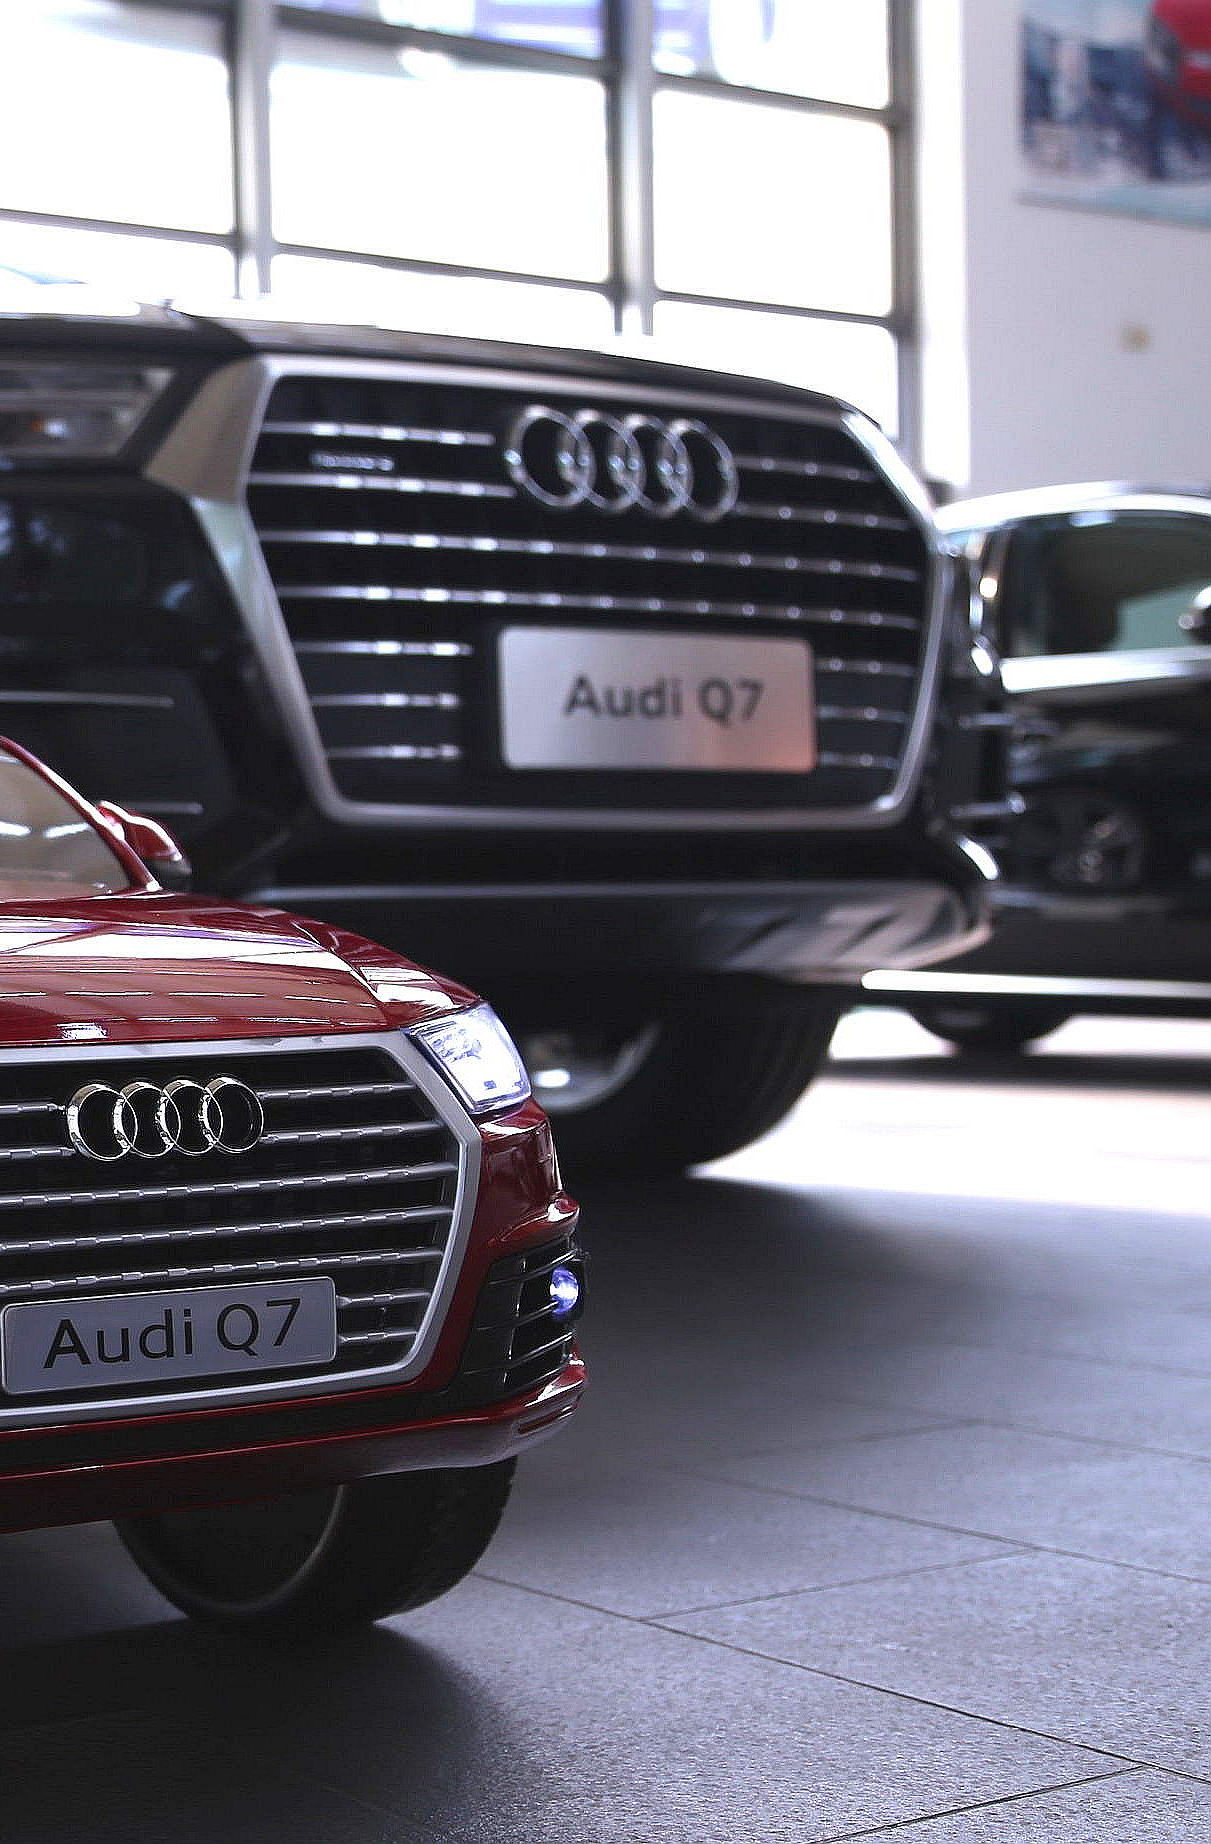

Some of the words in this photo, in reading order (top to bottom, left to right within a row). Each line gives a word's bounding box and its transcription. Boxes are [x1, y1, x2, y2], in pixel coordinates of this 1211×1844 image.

[563, 672, 684, 721] Audi
[697, 675, 765, 728] Q7
[43, 1308, 193, 1369] Audi
[216, 1297, 301, 1357] Q7
